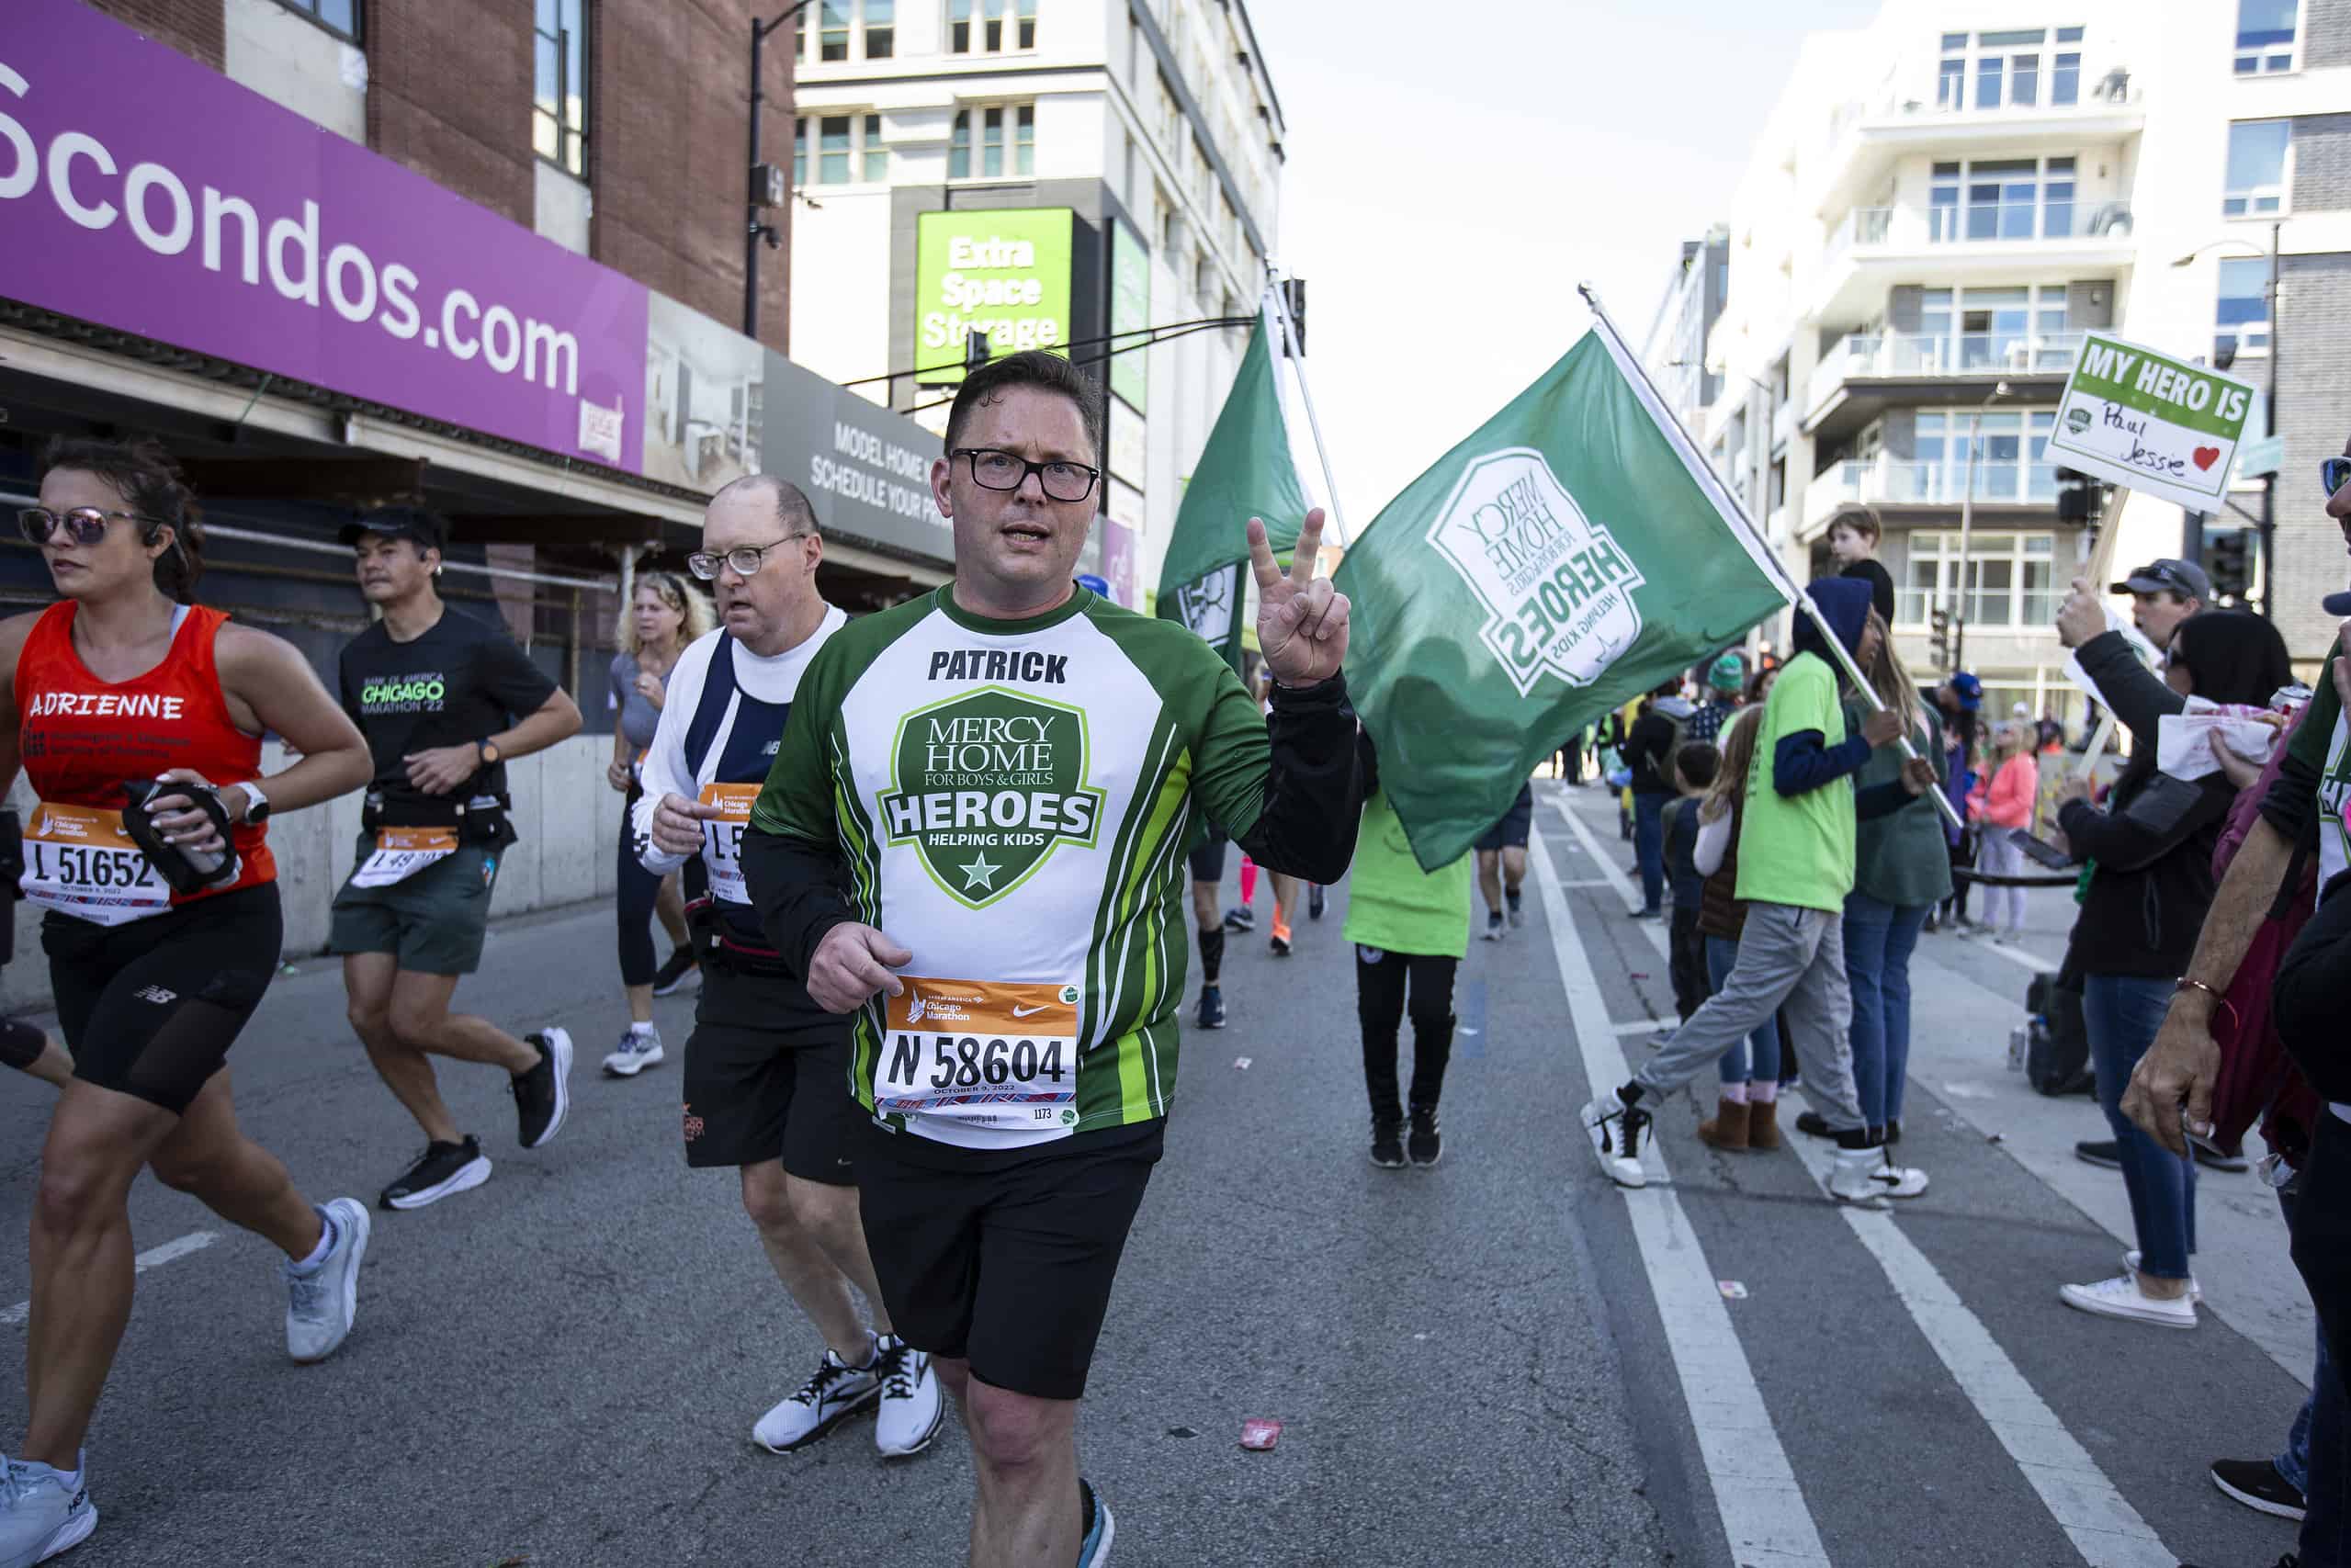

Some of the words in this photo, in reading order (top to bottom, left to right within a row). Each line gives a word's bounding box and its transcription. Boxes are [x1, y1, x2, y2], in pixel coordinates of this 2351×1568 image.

[949, 236, 1034, 269] Extra
[941, 272, 1043, 313] Space
[2081, 344, 2134, 384] MY
[2134, 360, 2211, 412] HERO
[2213, 386, 2245, 423] IS
[2102, 400, 2147, 436] Paul
[834, 421, 885, 468] MODEL
[886, 444, 923, 483] HOME
[2119, 438, 2186, 478] Jessie
[810, 455, 887, 508] SCHEDULE
[887, 483, 921, 521] YOUR
[927, 649, 1068, 684] PATRICK
[28, 692, 185, 720] ADRIENNE
[360, 699, 422, 714] MARATHON
[361, 681, 445, 705] CHICAGO
[925, 716, 1056, 745] MERCY
[924, 743, 1054, 773] HOME
[924, 773, 957, 786] FOR
[957, 773, 994, 786] BOYS
[1010, 772, 1054, 786] GIRLS
[887, 789, 1093, 835] HEROES
[928, 832, 999, 847] HELPING
[1003, 833, 1045, 847] KIDS
[59, 846, 155, 888] 51652
[926, 1001, 962, 1012] Chicago
[926, 1011, 970, 1021] Marathon
[887, 1034, 921, 1087] N
[930, 1036, 1067, 1089] 58604
[933, 1086, 979, 1095] OCTOBER
[1033, 1108, 1052, 1120] 1173
